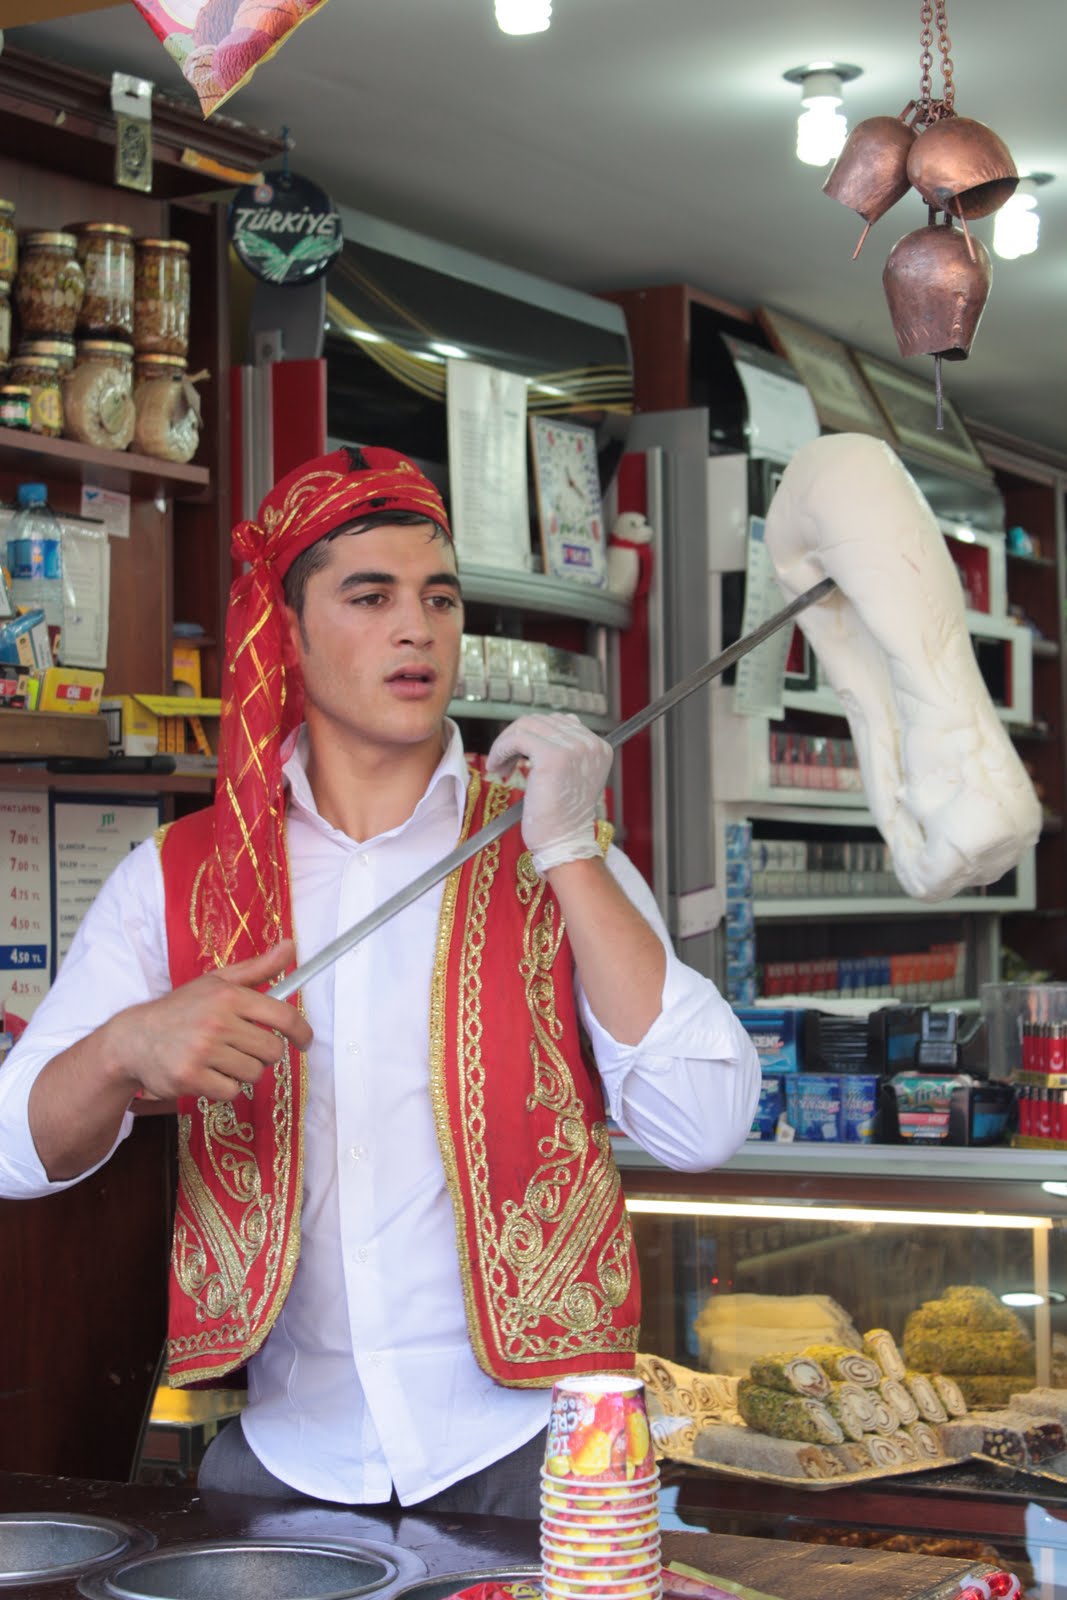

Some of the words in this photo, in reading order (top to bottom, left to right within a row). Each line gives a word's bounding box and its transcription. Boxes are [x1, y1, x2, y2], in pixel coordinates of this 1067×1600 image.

[235, 206, 339, 235] TÜRKİYE
[32, 954, 42, 963] TL
[550, 1411, 579, 1435] CRE
